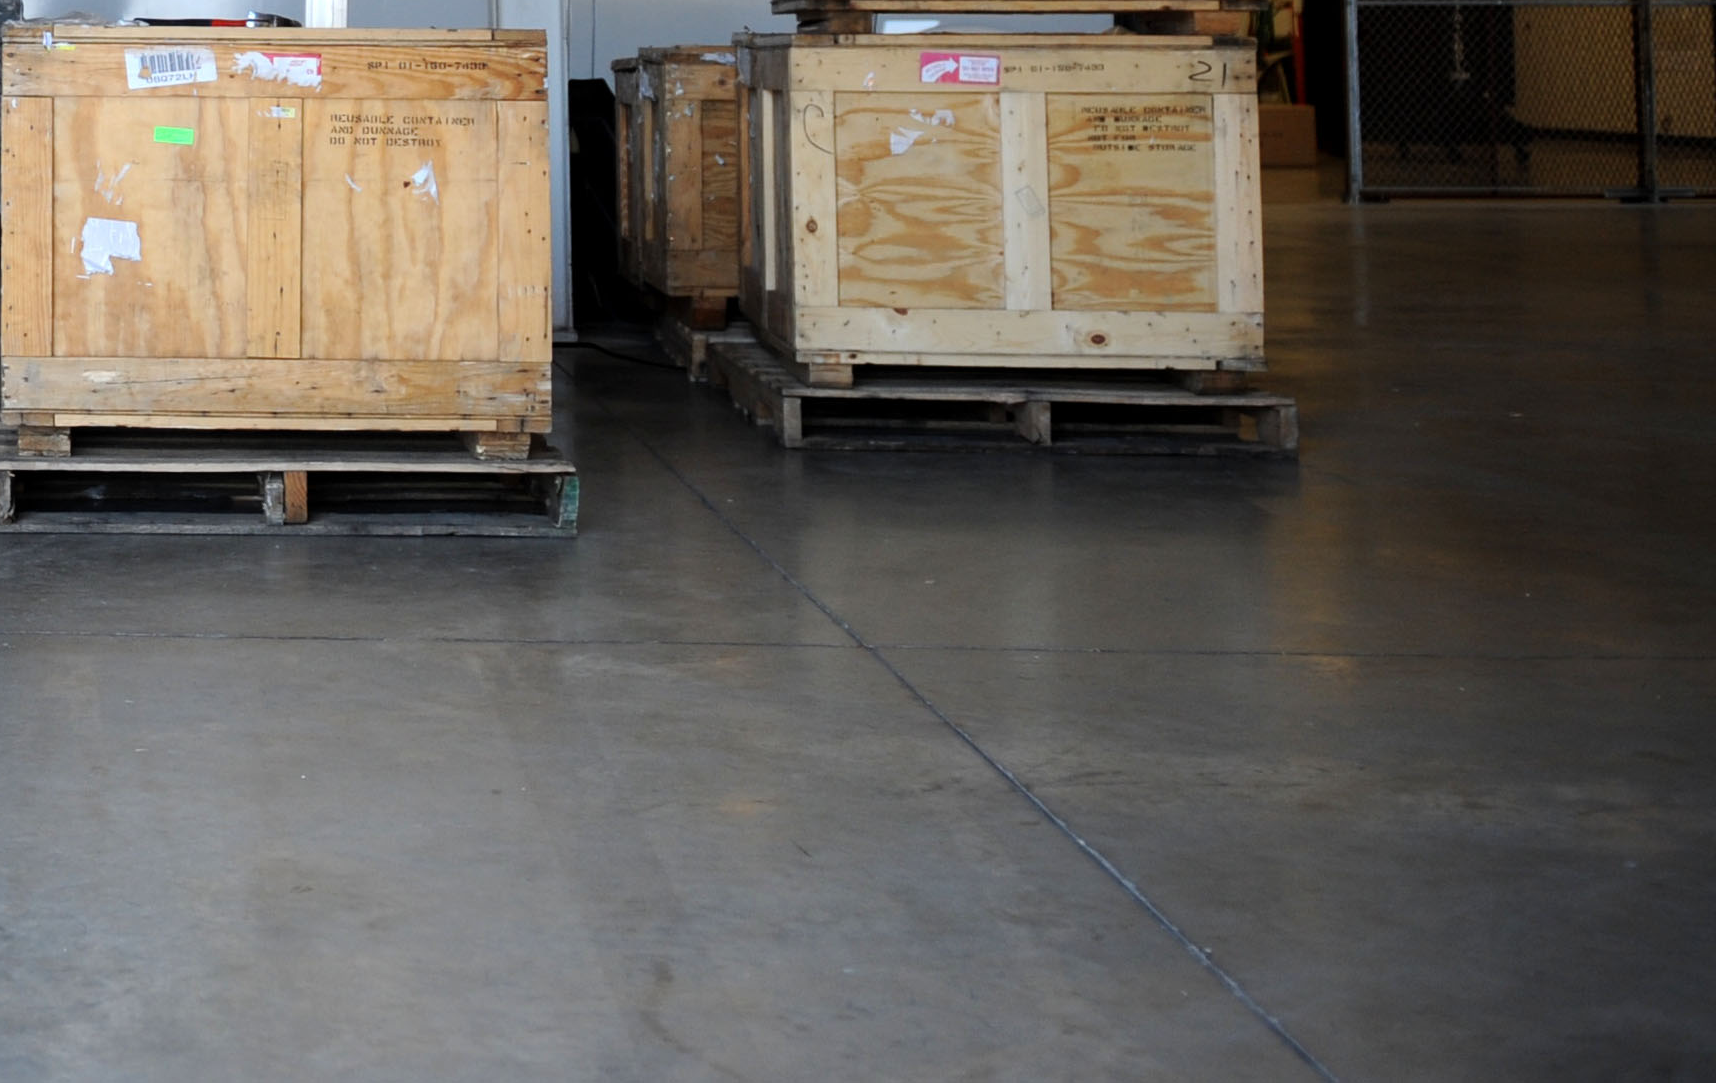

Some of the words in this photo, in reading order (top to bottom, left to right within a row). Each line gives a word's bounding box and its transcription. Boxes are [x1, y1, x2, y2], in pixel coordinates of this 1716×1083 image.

[330, 114, 394, 124] REUSABLE
[402, 116, 475, 126] CONTAINER
[330, 126, 353, 134] AND
[362, 127, 419, 136] DUNNAGE
[329, 137, 345, 145] DO
[353, 137, 377, 146] NOT
[386, 138, 441, 147] DESTROY
